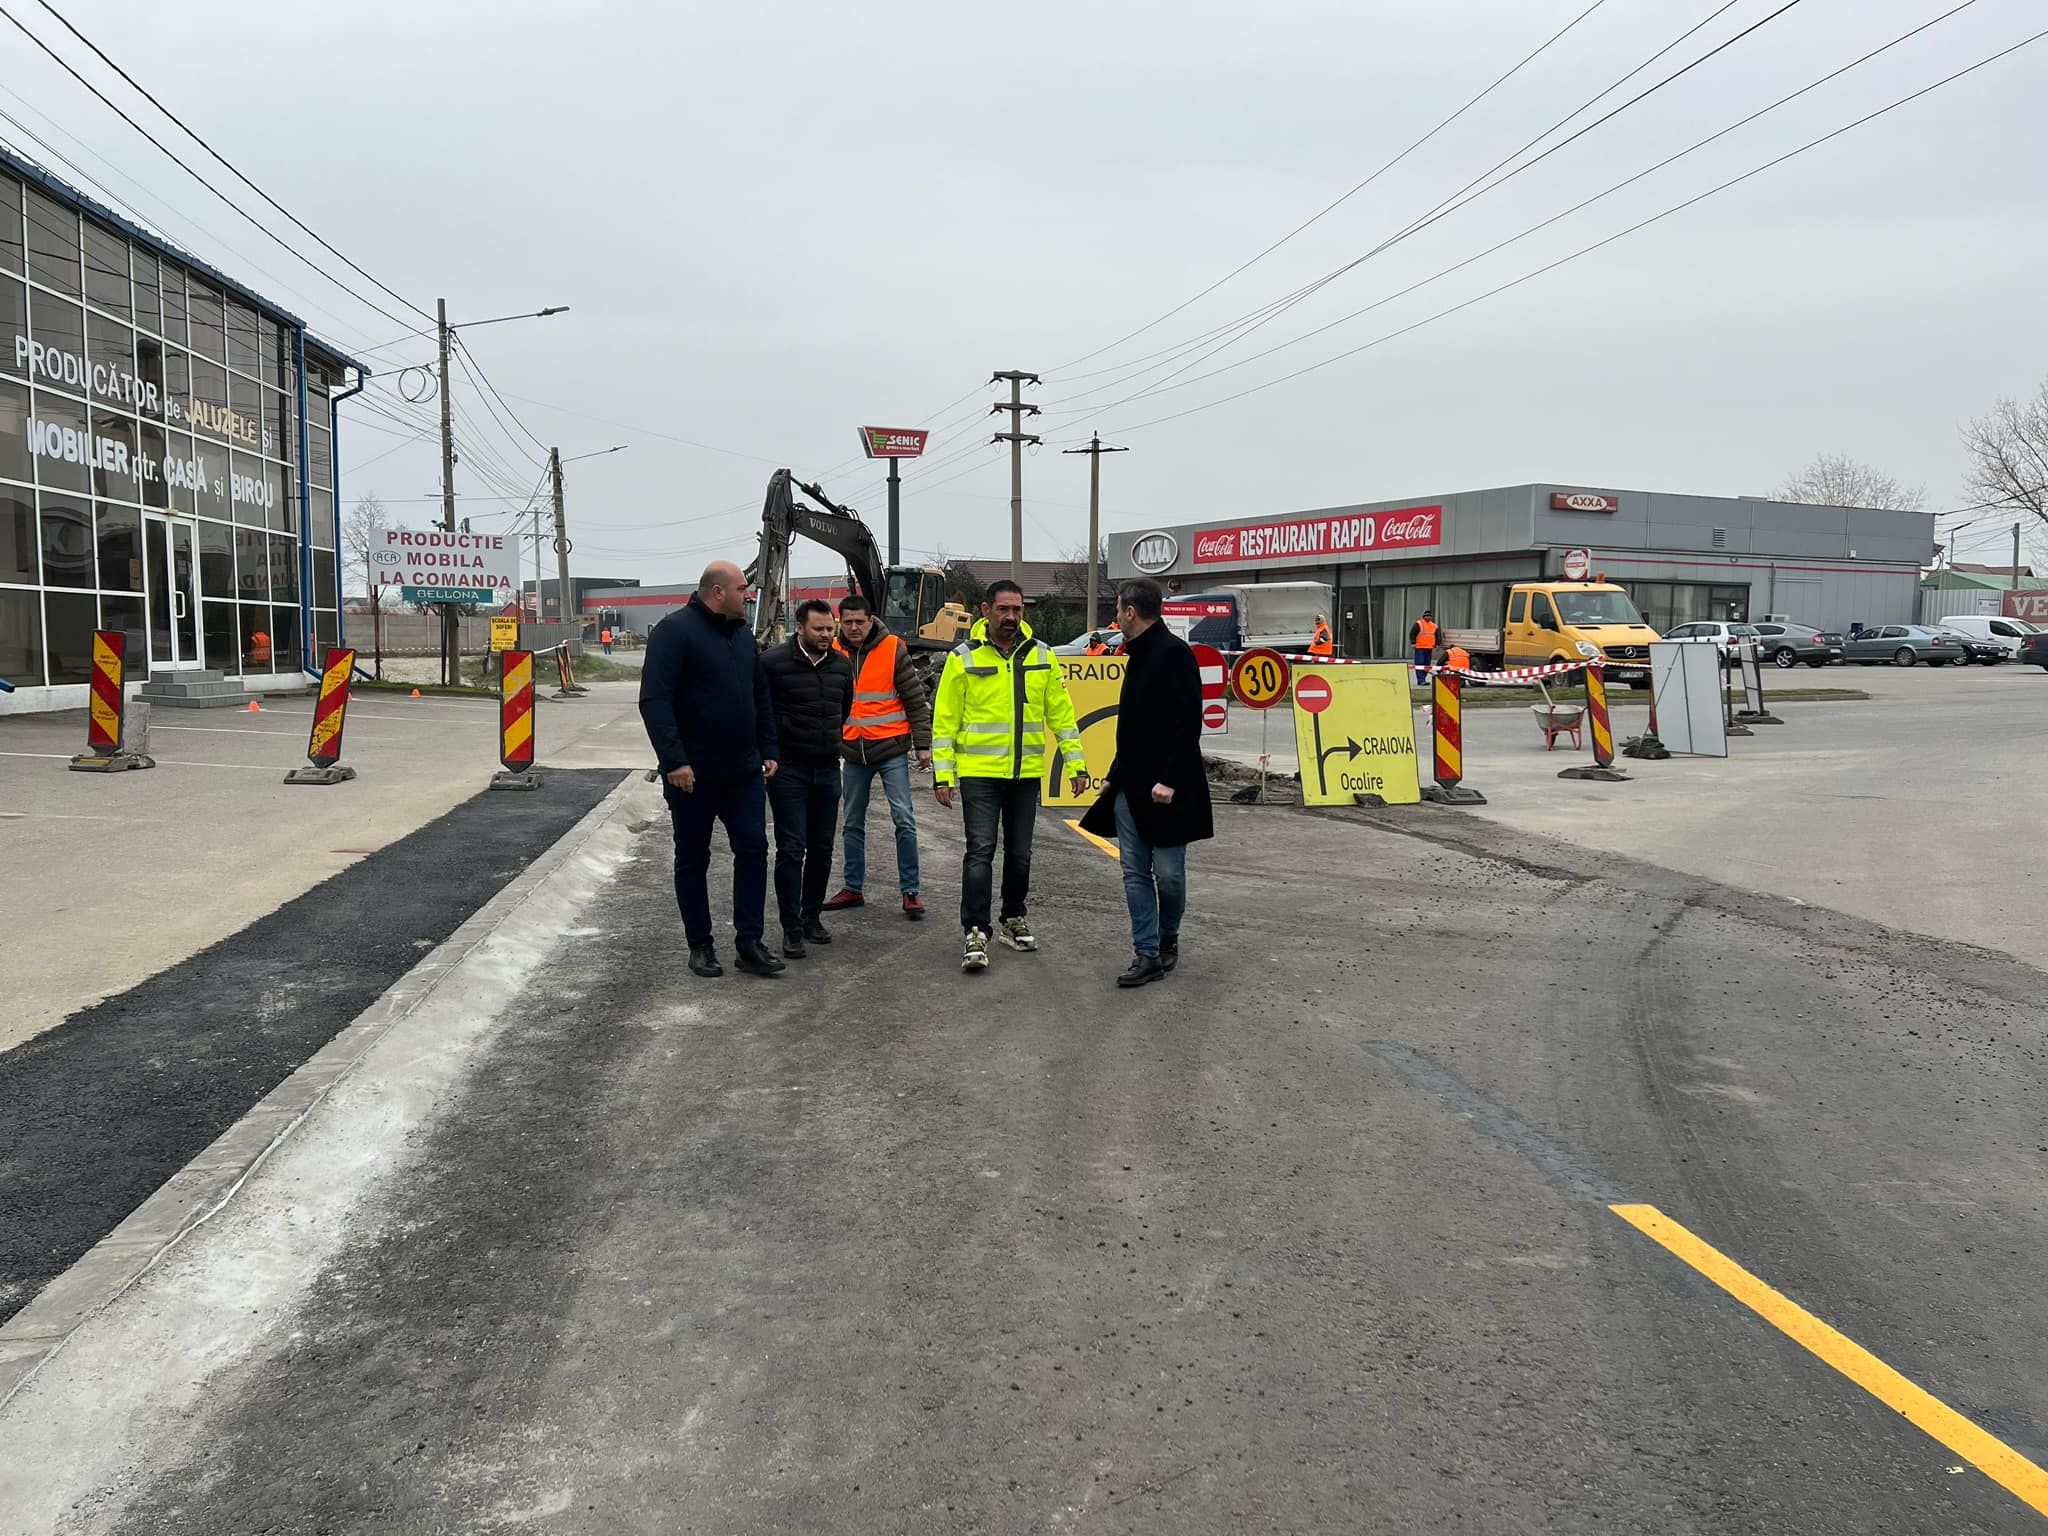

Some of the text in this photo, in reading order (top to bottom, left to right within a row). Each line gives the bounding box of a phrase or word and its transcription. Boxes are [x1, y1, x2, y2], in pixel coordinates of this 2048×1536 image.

[15, 334, 158, 412] PRODUCĂTOR
[166, 395, 181, 419] de
[184, 398, 258, 444] JALUZELE
[886, 435, 920, 446] SENIC
[26, 416, 128, 475] MOBILIER
[163, 455, 208, 493] CASĂ
[231, 472, 273, 508] BIROU
[1571, 496, 1602, 508] AXXA
[386, 531, 504, 549] PRODUCTIE
[1239, 522, 1327, 557] RESTAURANT
[1331, 517, 1376, 549] RAPID
[1381, 513, 1436, 542] Coca-Cola
[376, 552, 397, 562] ACA
[407, 552, 484, 568] MOBILA
[1137, 539, 1172, 565] AXXA
[380, 571, 511, 588] LA COMANDA
[416, 589, 480, 600] BELLONA
[1245, 661, 1276, 696] 30
[1363, 736, 1414, 755] CRAIOVA
[1341, 772, 1384, 790] Ocolire
